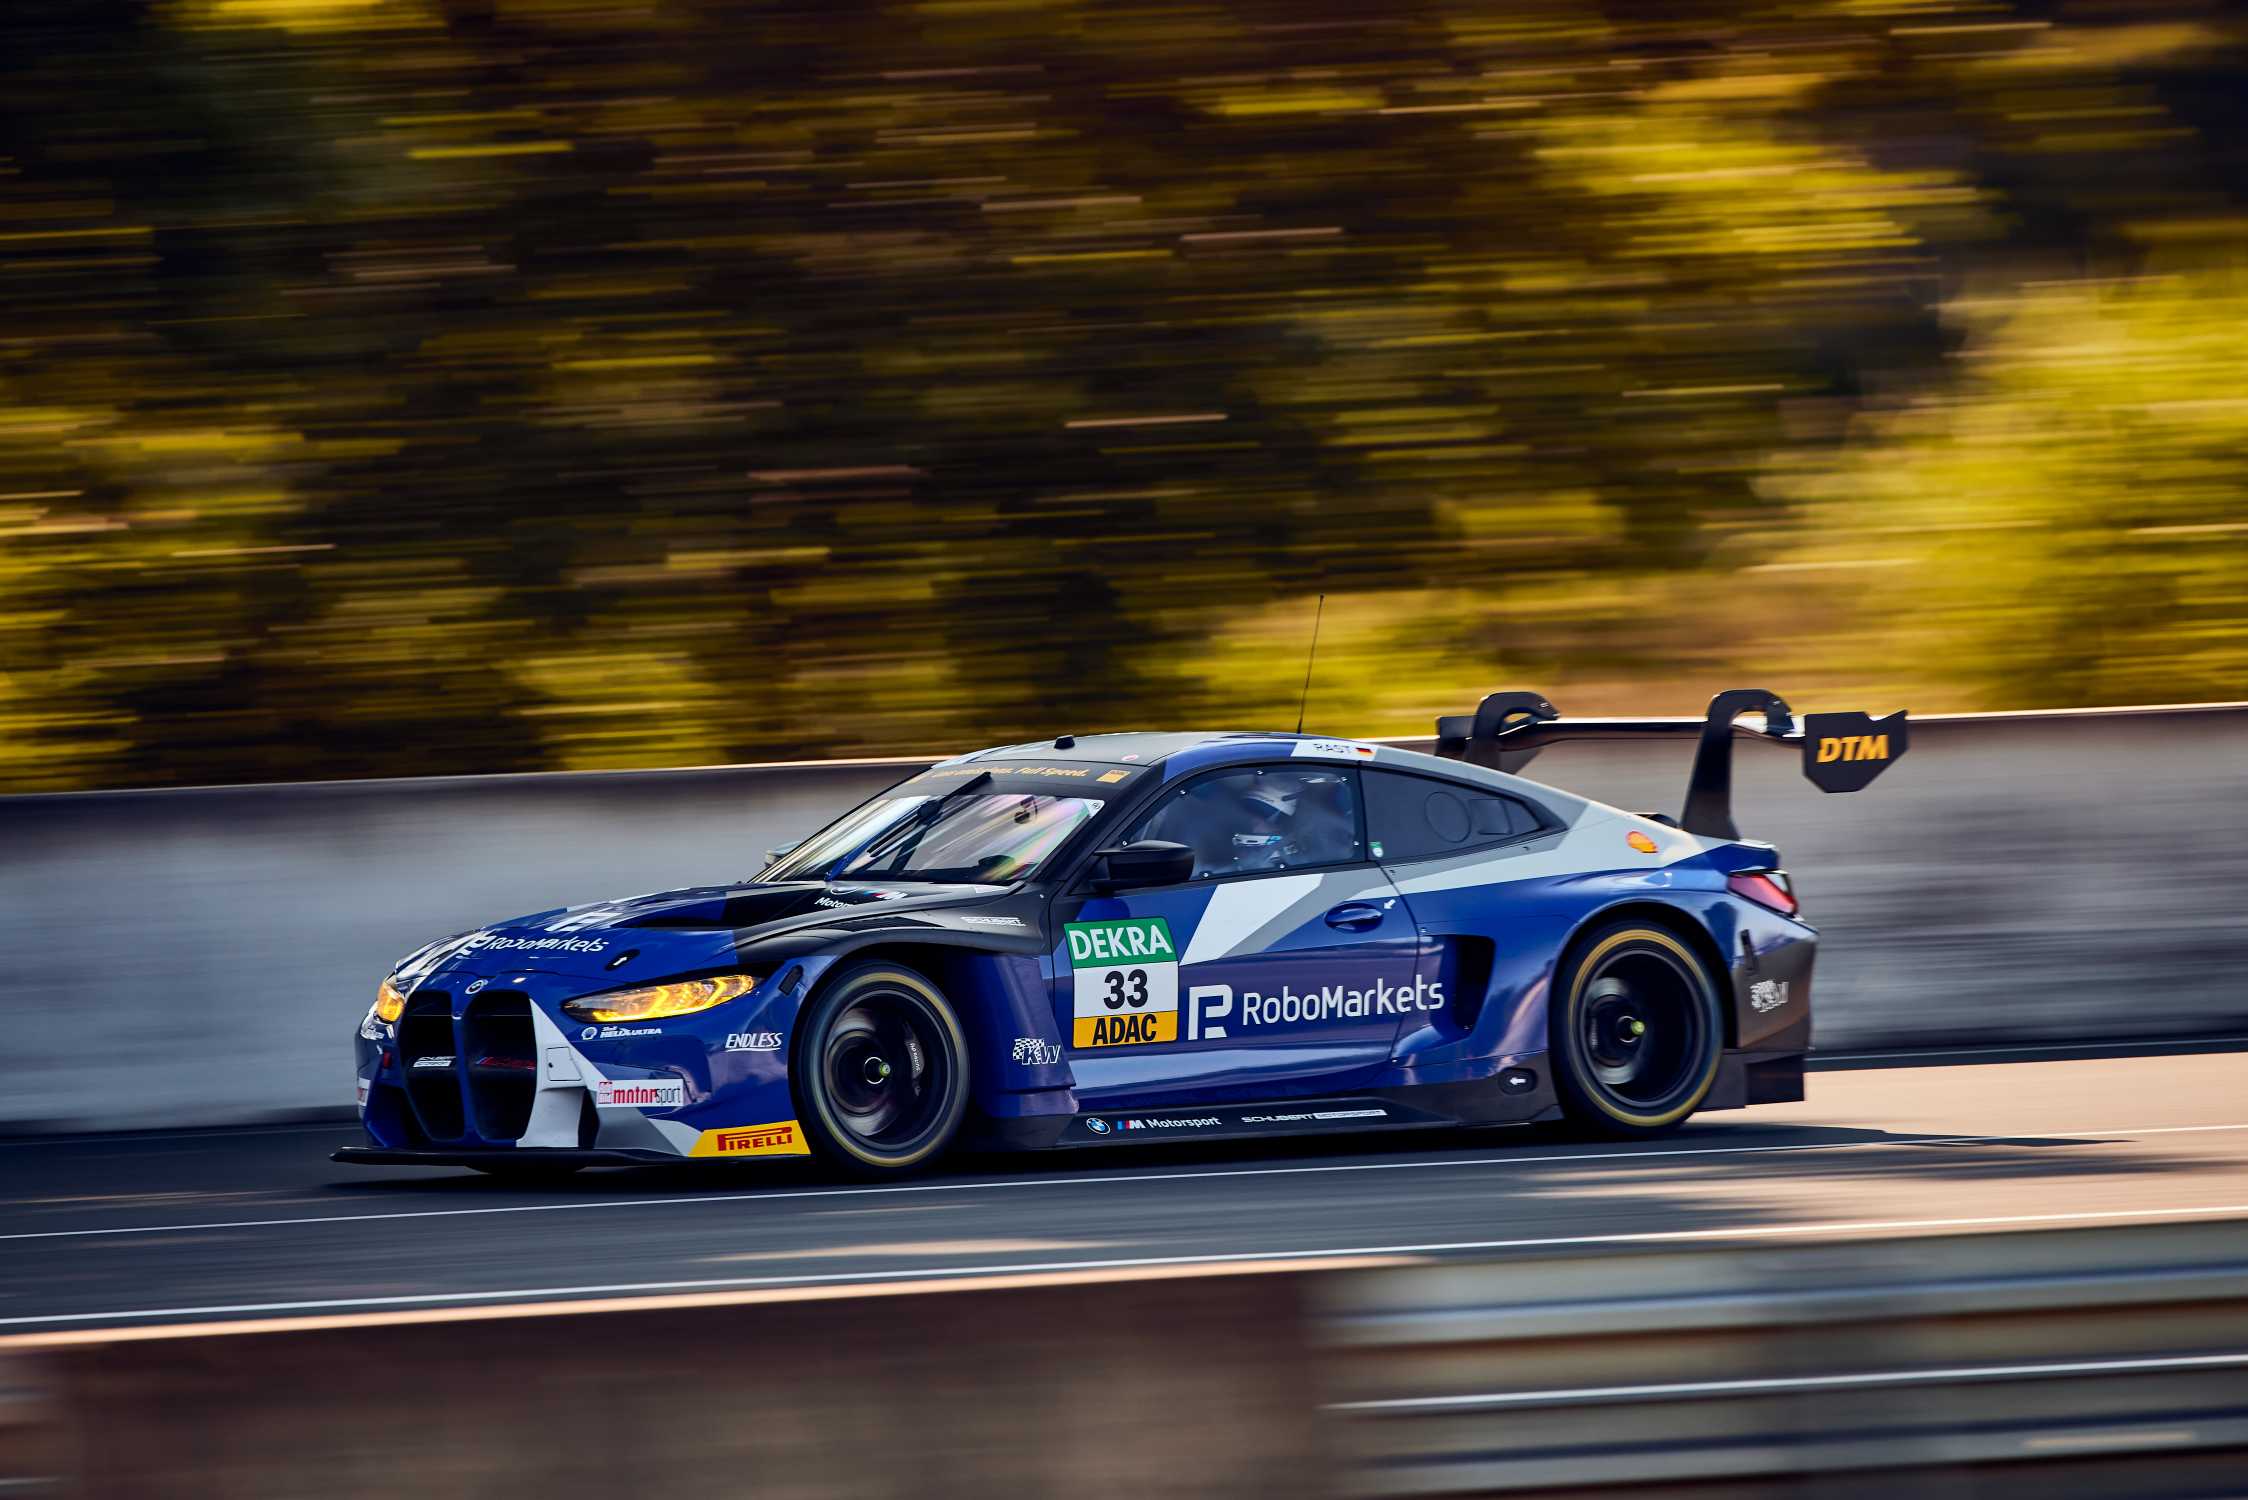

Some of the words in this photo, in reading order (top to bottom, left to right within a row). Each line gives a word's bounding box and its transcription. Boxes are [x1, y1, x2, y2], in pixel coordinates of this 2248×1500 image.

[1816, 734, 1889, 763] DTM
[1068, 924, 1173, 961] DEKRA
[1103, 968, 1149, 1010] 33
[1242, 974, 1445, 1026] RoboMarkets
[725, 1032, 783, 1049] ENDLESS
[1092, 1013, 1157, 1046] ADAC
[613, 1086, 681, 1105] motorsport
[1146, 1117, 1223, 1129] Motorsport
[1241, 1113, 1313, 1123] SCHUBERT
[717, 1127, 793, 1152] PIRELLI
